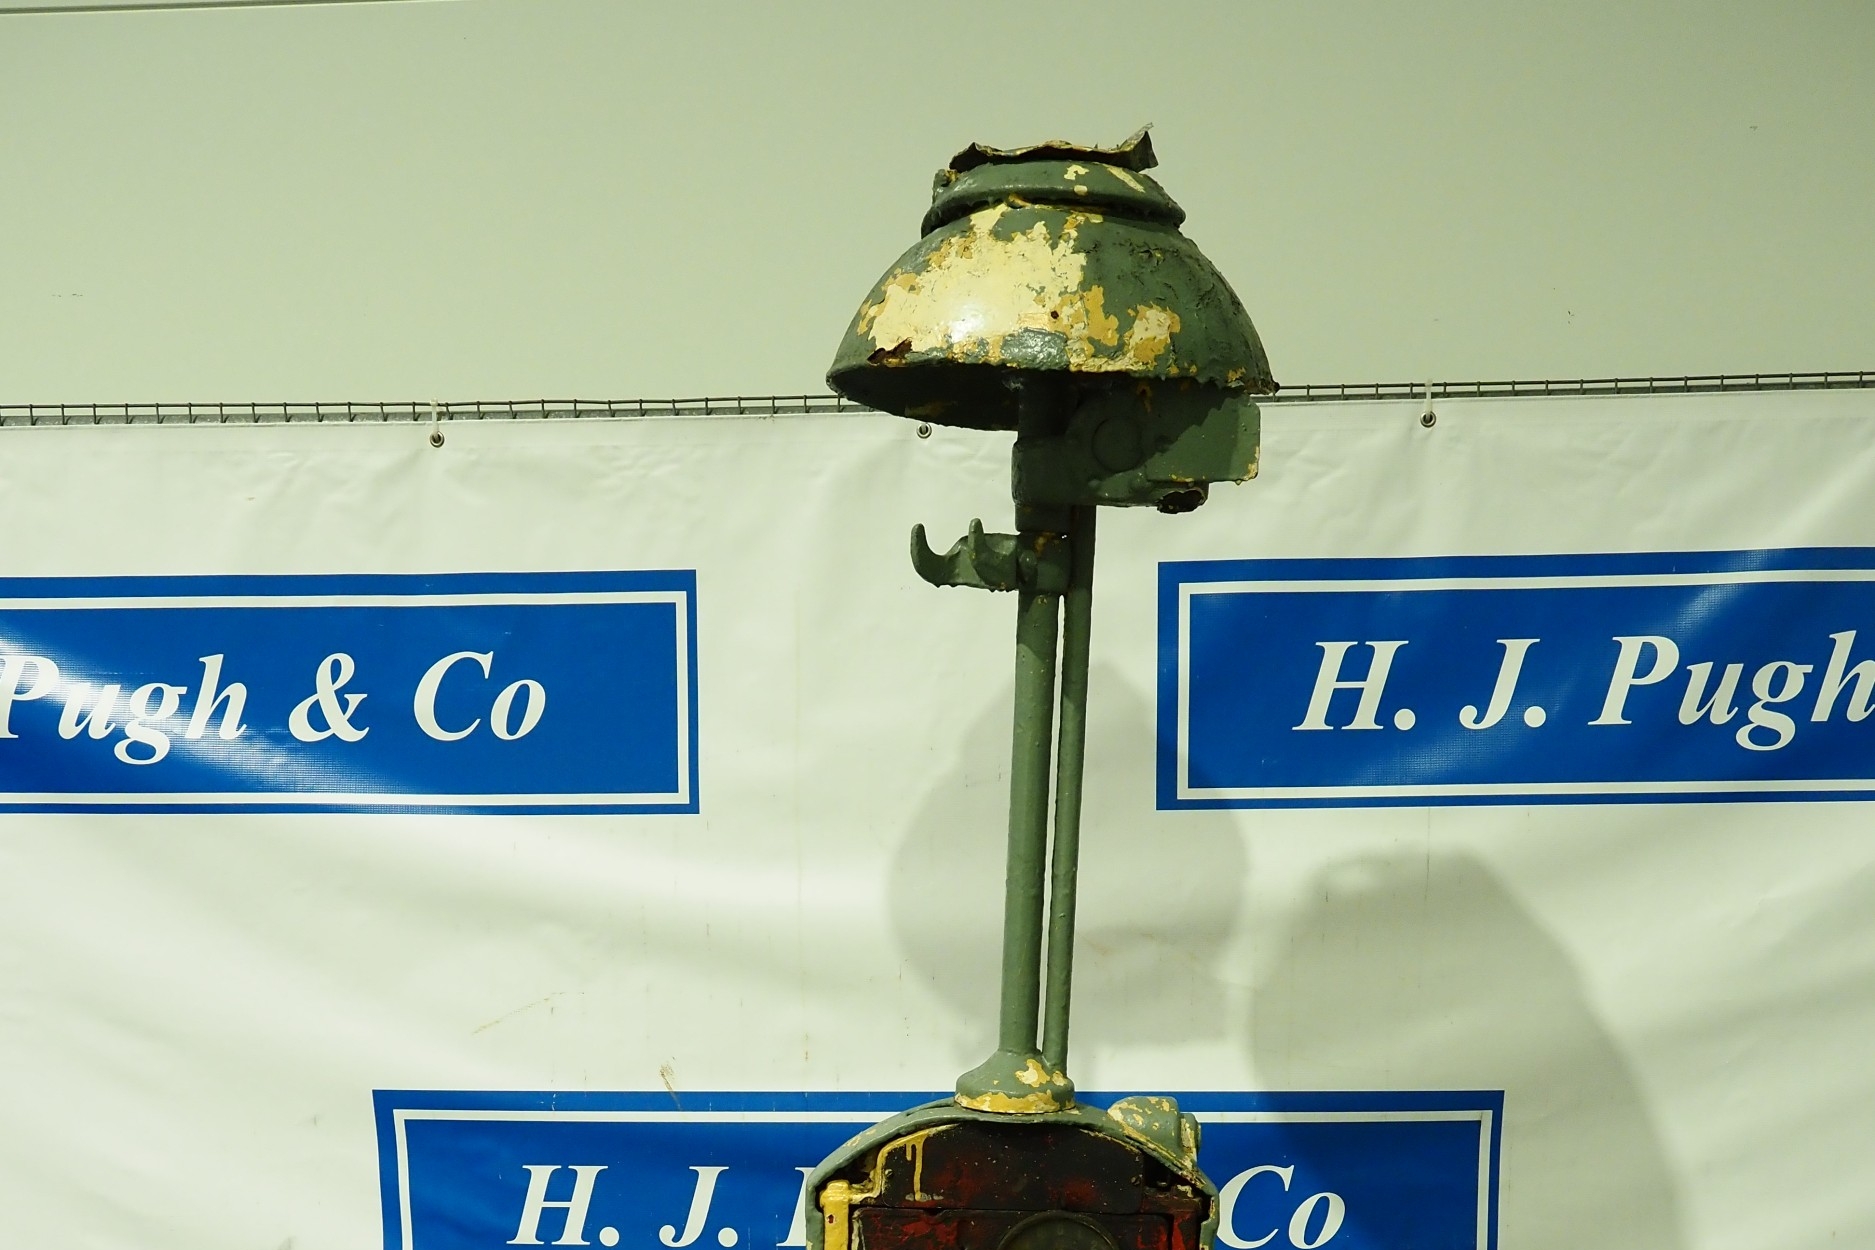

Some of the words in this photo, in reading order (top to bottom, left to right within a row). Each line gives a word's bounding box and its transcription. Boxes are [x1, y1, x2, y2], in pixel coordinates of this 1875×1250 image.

[289, 652, 370, 743] &
[414, 650, 546, 742] Co
[1291, 640, 1416, 731] H.
[1459, 638, 1547, 730] J.
[1587, 629, 1875, 751] Pugh
[506, 1164, 620, 1247] H.
[658, 1165, 739, 1248] J.
[1216, 1164, 1346, 1250] Co
